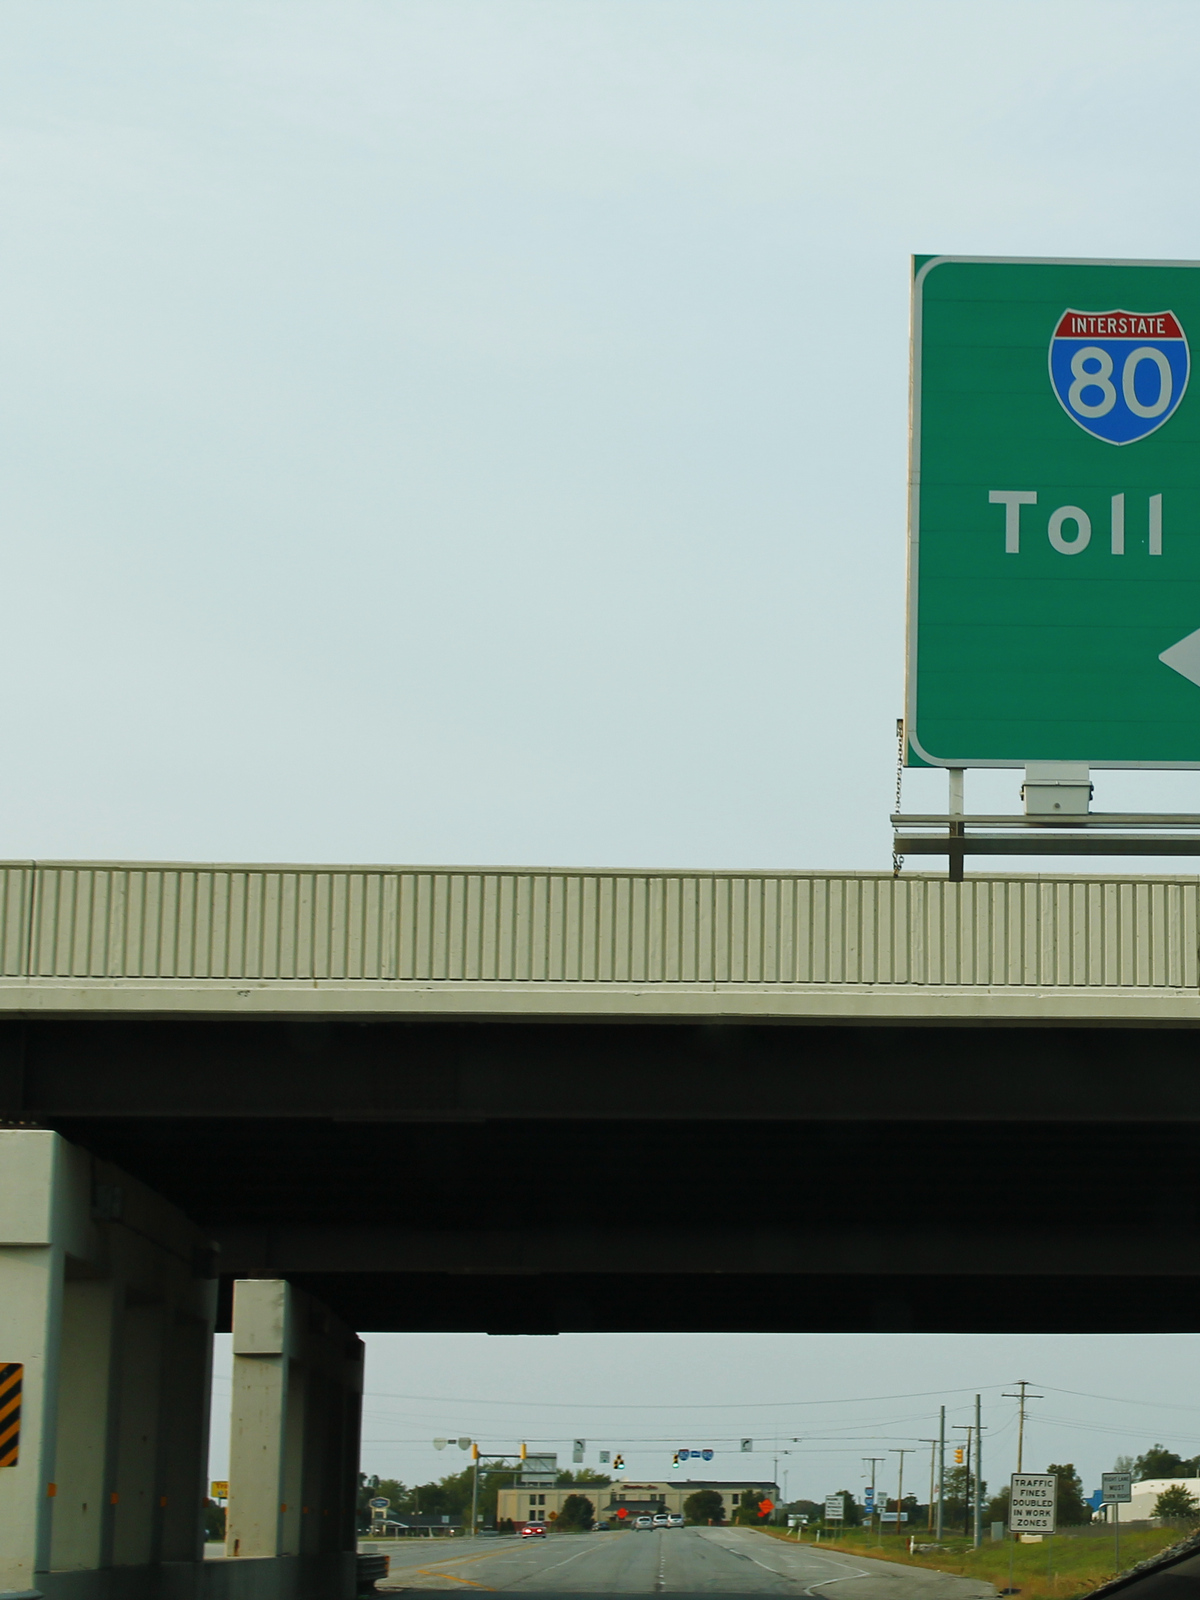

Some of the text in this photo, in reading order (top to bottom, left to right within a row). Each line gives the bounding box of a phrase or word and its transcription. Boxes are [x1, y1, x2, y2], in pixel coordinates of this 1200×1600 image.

[1071, 317, 1166, 336] INTERSTATE
[1068, 346, 1173, 418] 80
[988, 490, 1162, 556] Toll
[1014, 1479, 1053, 1487] TRAFFIC
[1020, 1489, 1047, 1497] FINES
[1012, 1499, 1053, 1507] DOUBLED
[1025, 1509, 1051, 1517] WORK
[1017, 1519, 1047, 1527] ZONES
